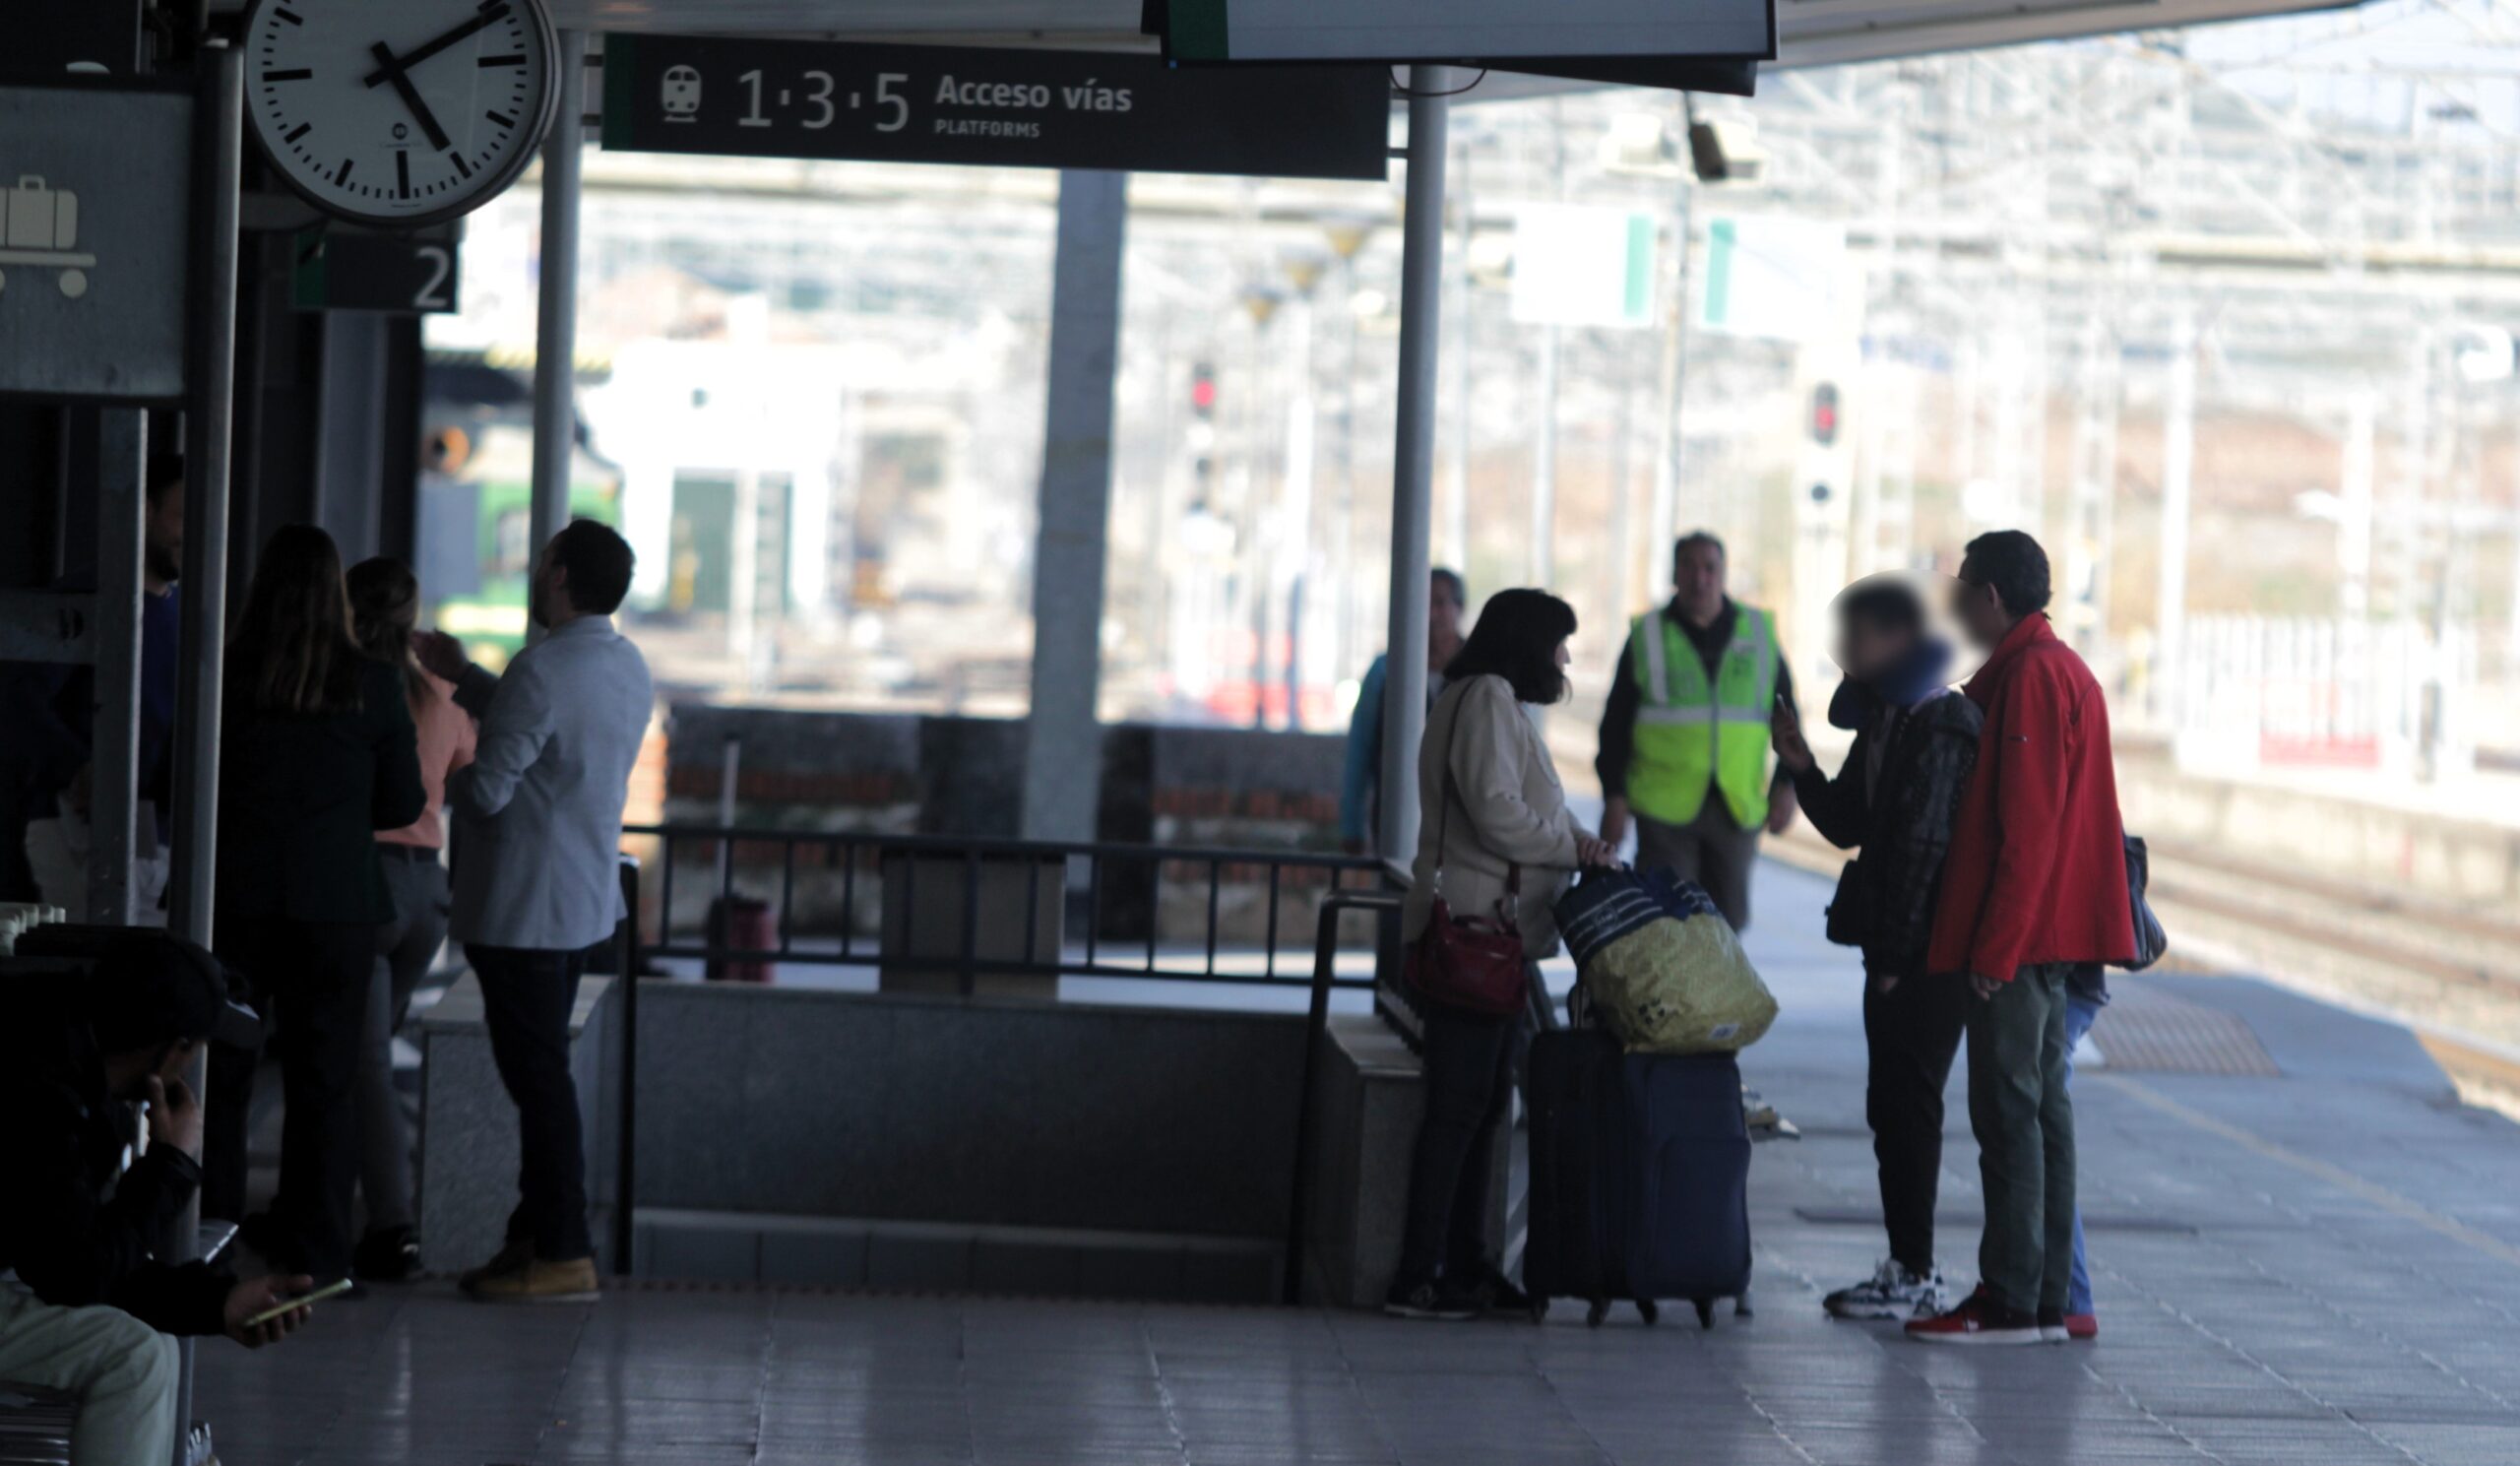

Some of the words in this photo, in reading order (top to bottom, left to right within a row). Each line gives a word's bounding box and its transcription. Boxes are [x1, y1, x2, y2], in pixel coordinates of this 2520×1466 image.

[935, 74, 1050, 108] Acceso
[1062, 78, 1133, 112] vías
[935, 118, 1041, 138] PLATFORMS
[413, 246, 450, 307] 2
